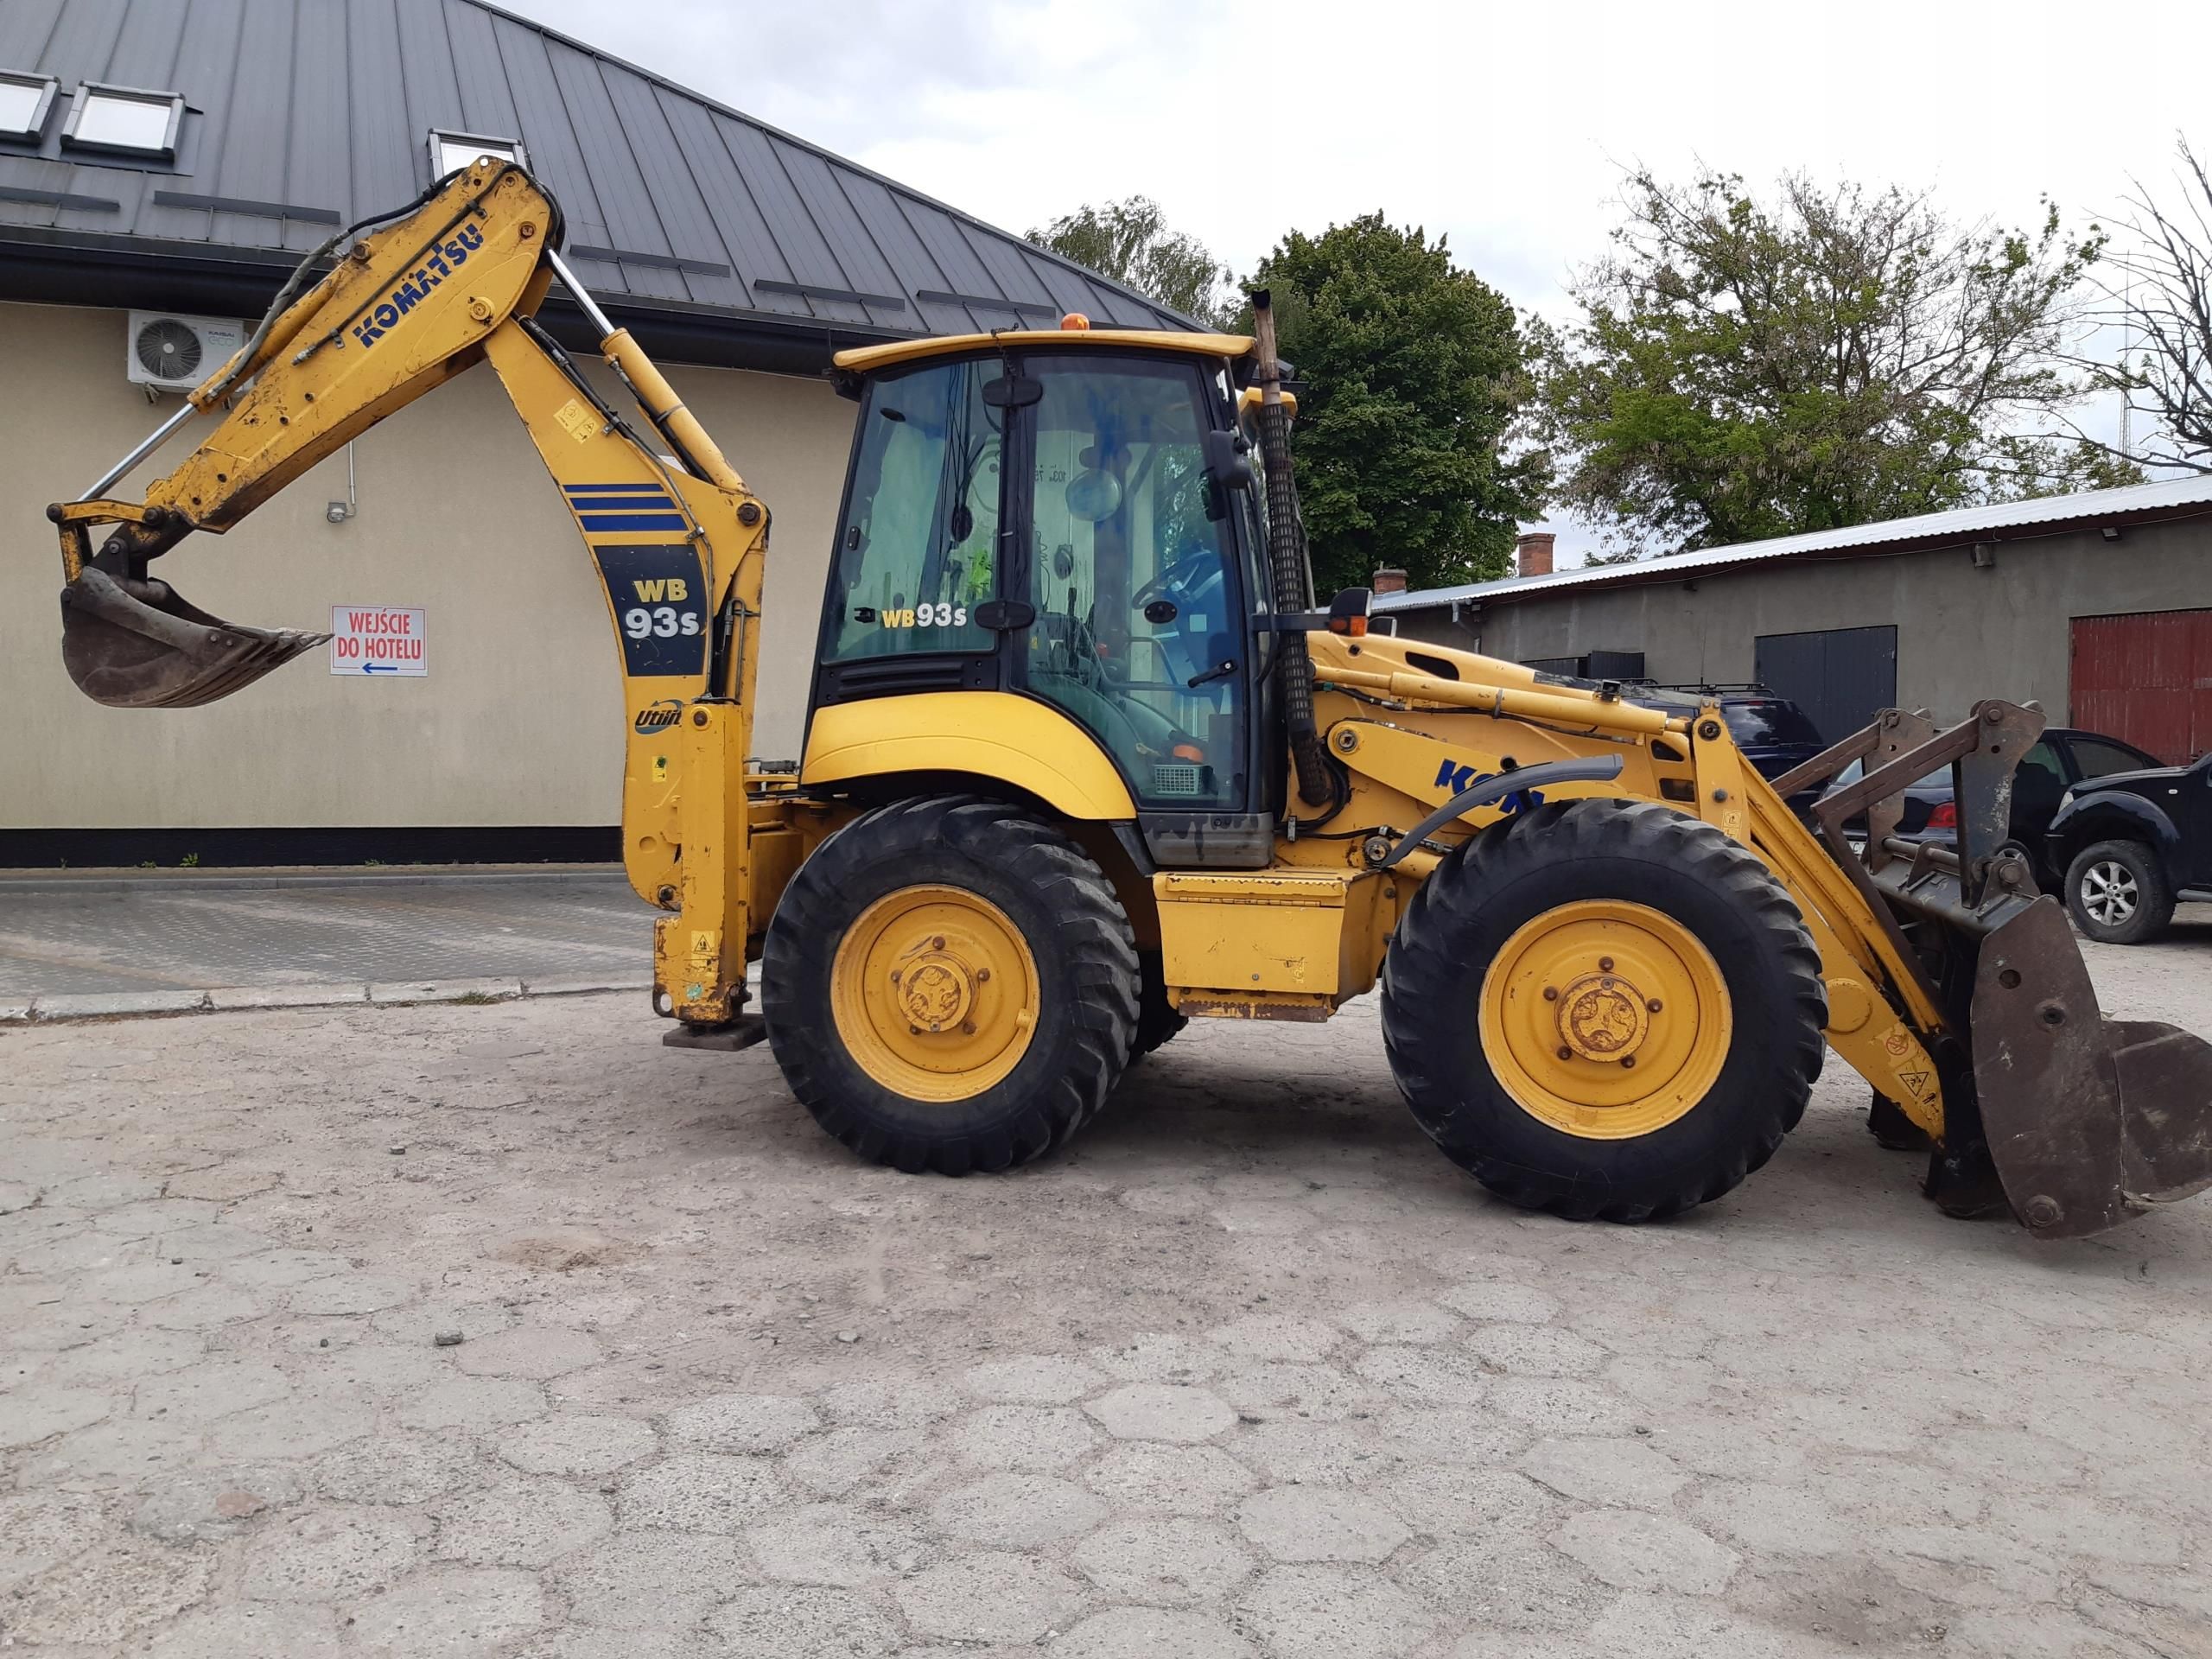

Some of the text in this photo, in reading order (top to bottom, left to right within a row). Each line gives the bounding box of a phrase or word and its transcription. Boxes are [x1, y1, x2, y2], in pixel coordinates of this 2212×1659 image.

[353, 222, 485, 349] KOMATSU
[633, 578, 689, 603] WB
[348, 607, 410, 634] WEJŚCIE
[625, 607, 700, 639] 93s
[338, 637, 421, 659] DO HOTELU
